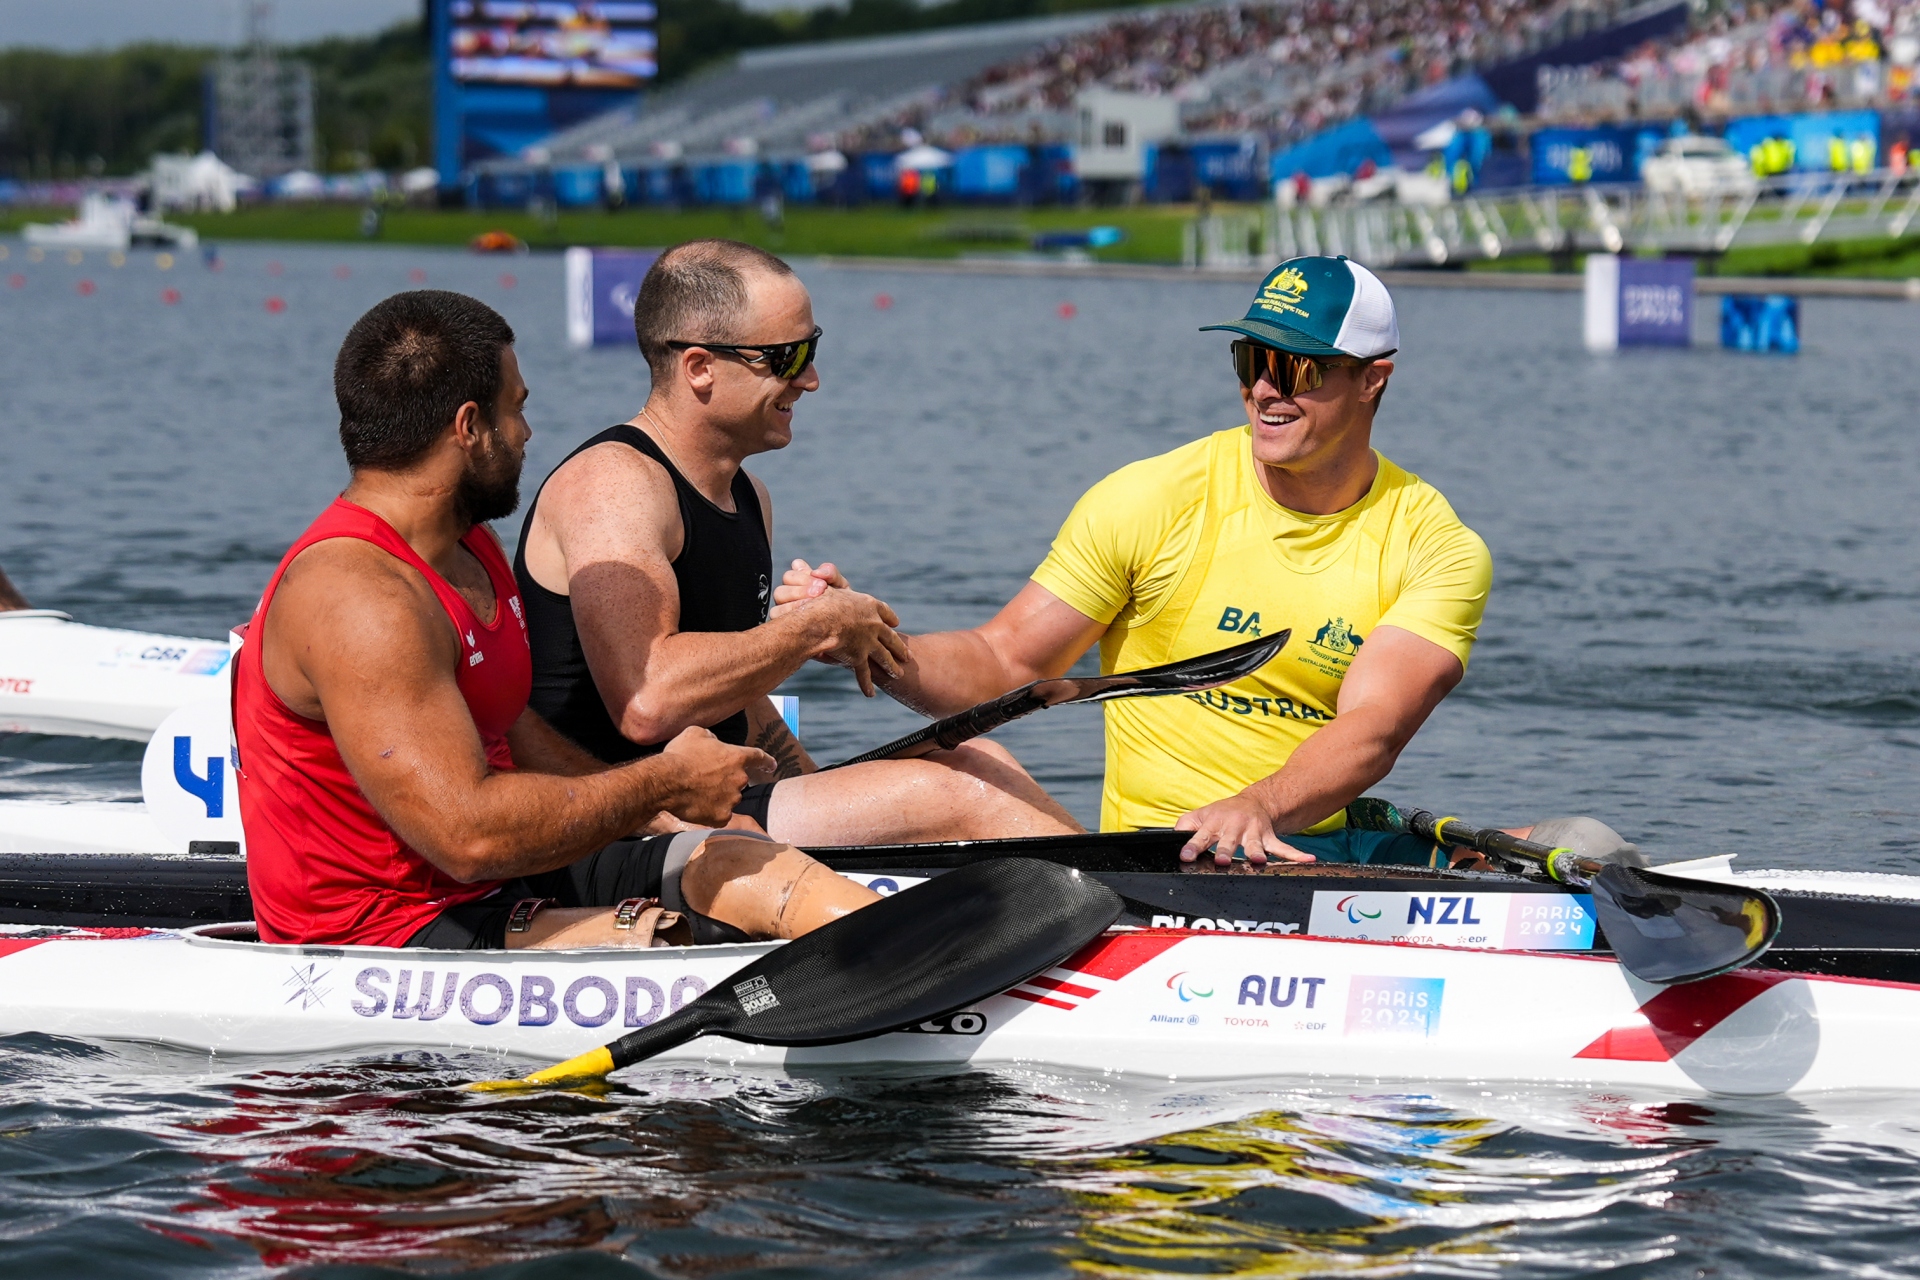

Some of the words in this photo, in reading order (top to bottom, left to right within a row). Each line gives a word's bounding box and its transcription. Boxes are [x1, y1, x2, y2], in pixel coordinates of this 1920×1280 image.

[1295, 307, 1310, 318] TEAM
[1298, 657, 1327, 668] AUSTRALIAN
[173, 736, 224, 818] 4
[1406, 897, 1481, 925] NZL
[1519, 922, 1582, 936] 2024
[1391, 935, 1434, 943] TOYOTA
[1237, 974, 1326, 1009] AUT
[742, 993, 776, 1011] canoe
[1150, 1014, 1185, 1024] Allianz
[1223, 1017, 1270, 1028] TOYOTA
[1359, 1007, 1427, 1026] 2024
